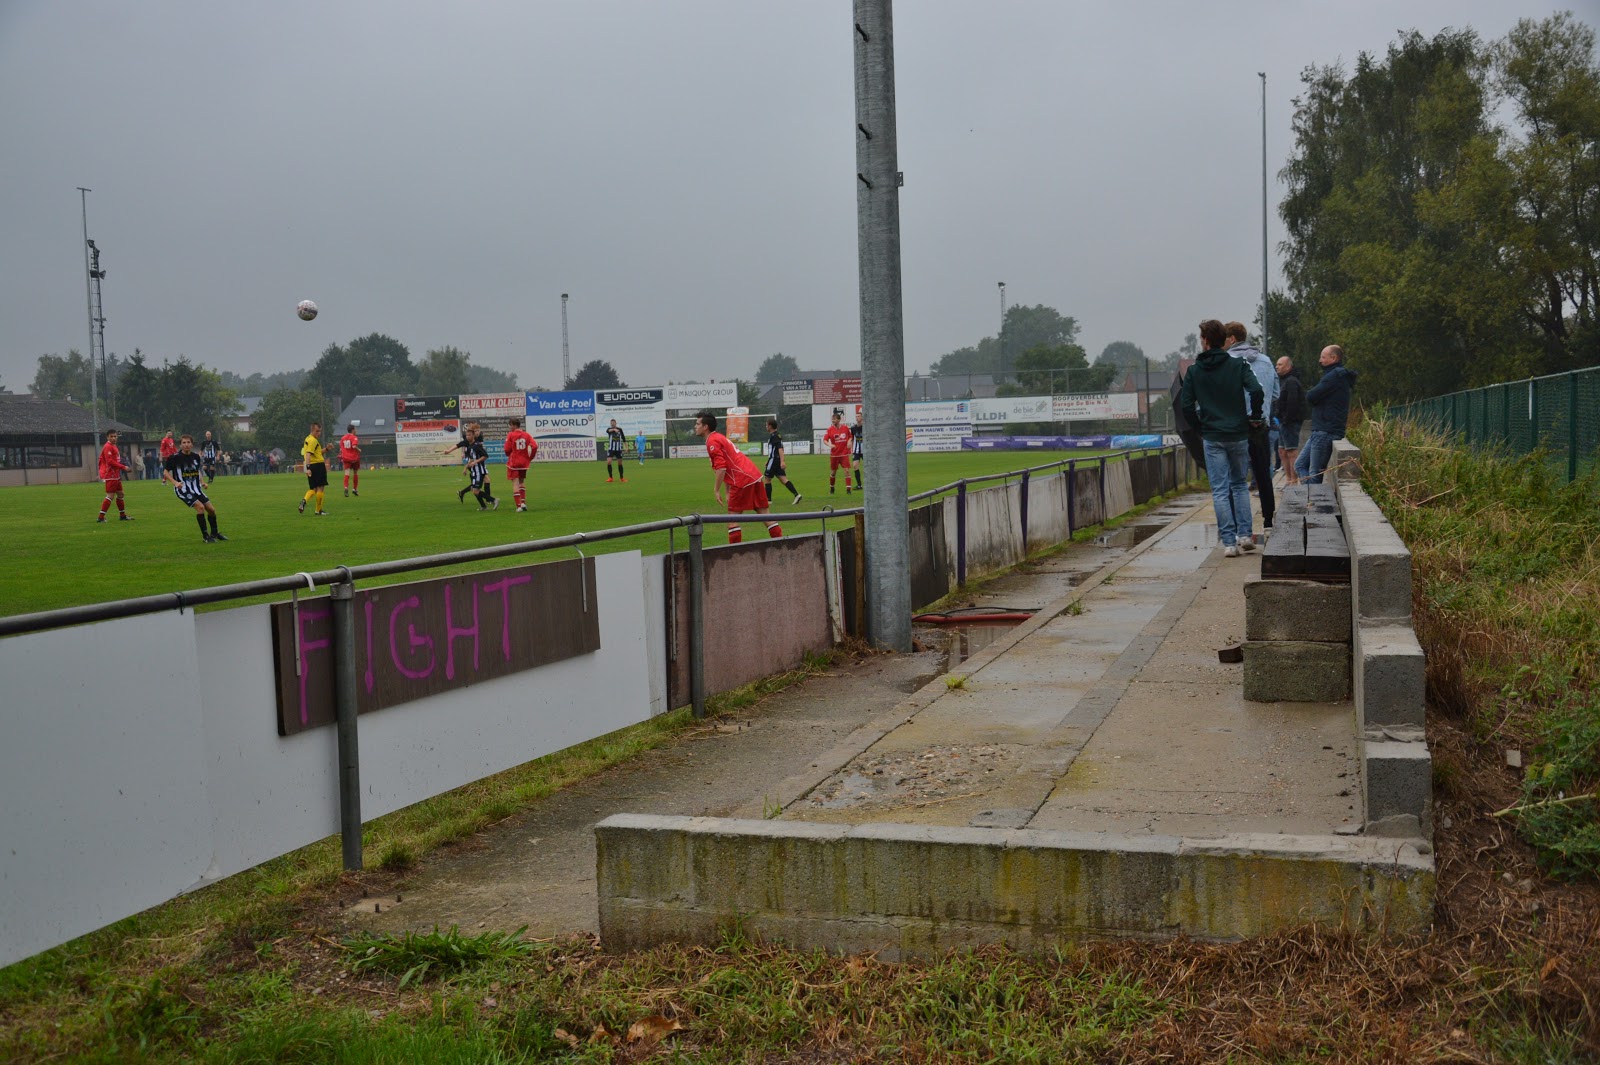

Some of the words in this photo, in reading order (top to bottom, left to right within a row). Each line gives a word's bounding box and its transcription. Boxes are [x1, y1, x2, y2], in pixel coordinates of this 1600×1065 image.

[603, 392, 655, 401] EURODAL
[461, 399, 481, 409] PAUL
[482, 398, 497, 408] VAN
[498, 397, 525, 408] OLMEN
[539, 400, 557, 409] Van
[558, 399, 570, 408] de
[571, 398, 592, 408] Poel
[535, 419, 549, 427] DP
[551, 418, 589, 427] WORLD
[343, 439, 351, 449] 10
[514, 438, 526, 450] 13
[547, 450, 568, 459] VOALE
[298, 575, 532, 725] FIGHT
